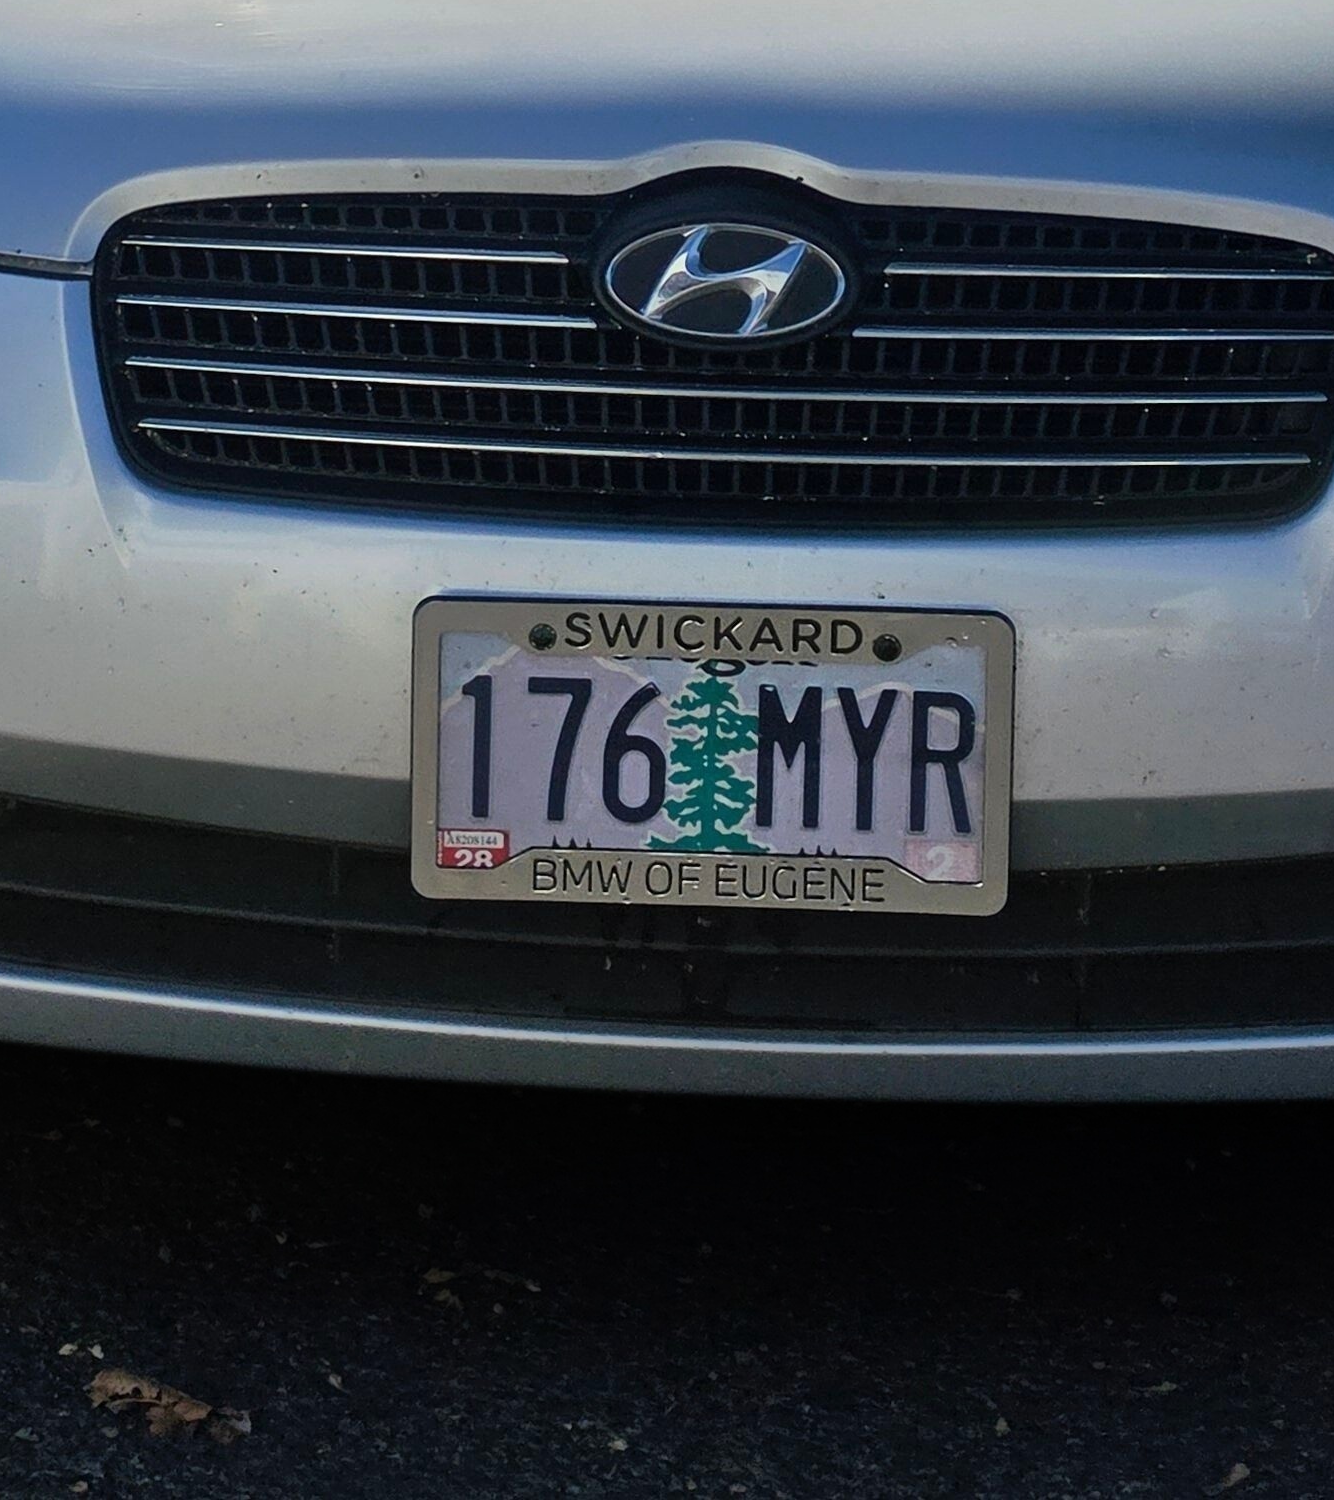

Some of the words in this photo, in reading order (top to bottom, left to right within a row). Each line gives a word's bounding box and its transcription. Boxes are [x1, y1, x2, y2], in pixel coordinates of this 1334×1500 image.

[564, 611, 863, 656] SWICKARD
[461, 674, 668, 824] 176
[755, 683, 976, 833] MYR
[531, 858, 632, 896] BMW
[644, 862, 699, 898] OF
[715, 864, 886, 904] EUGENE
